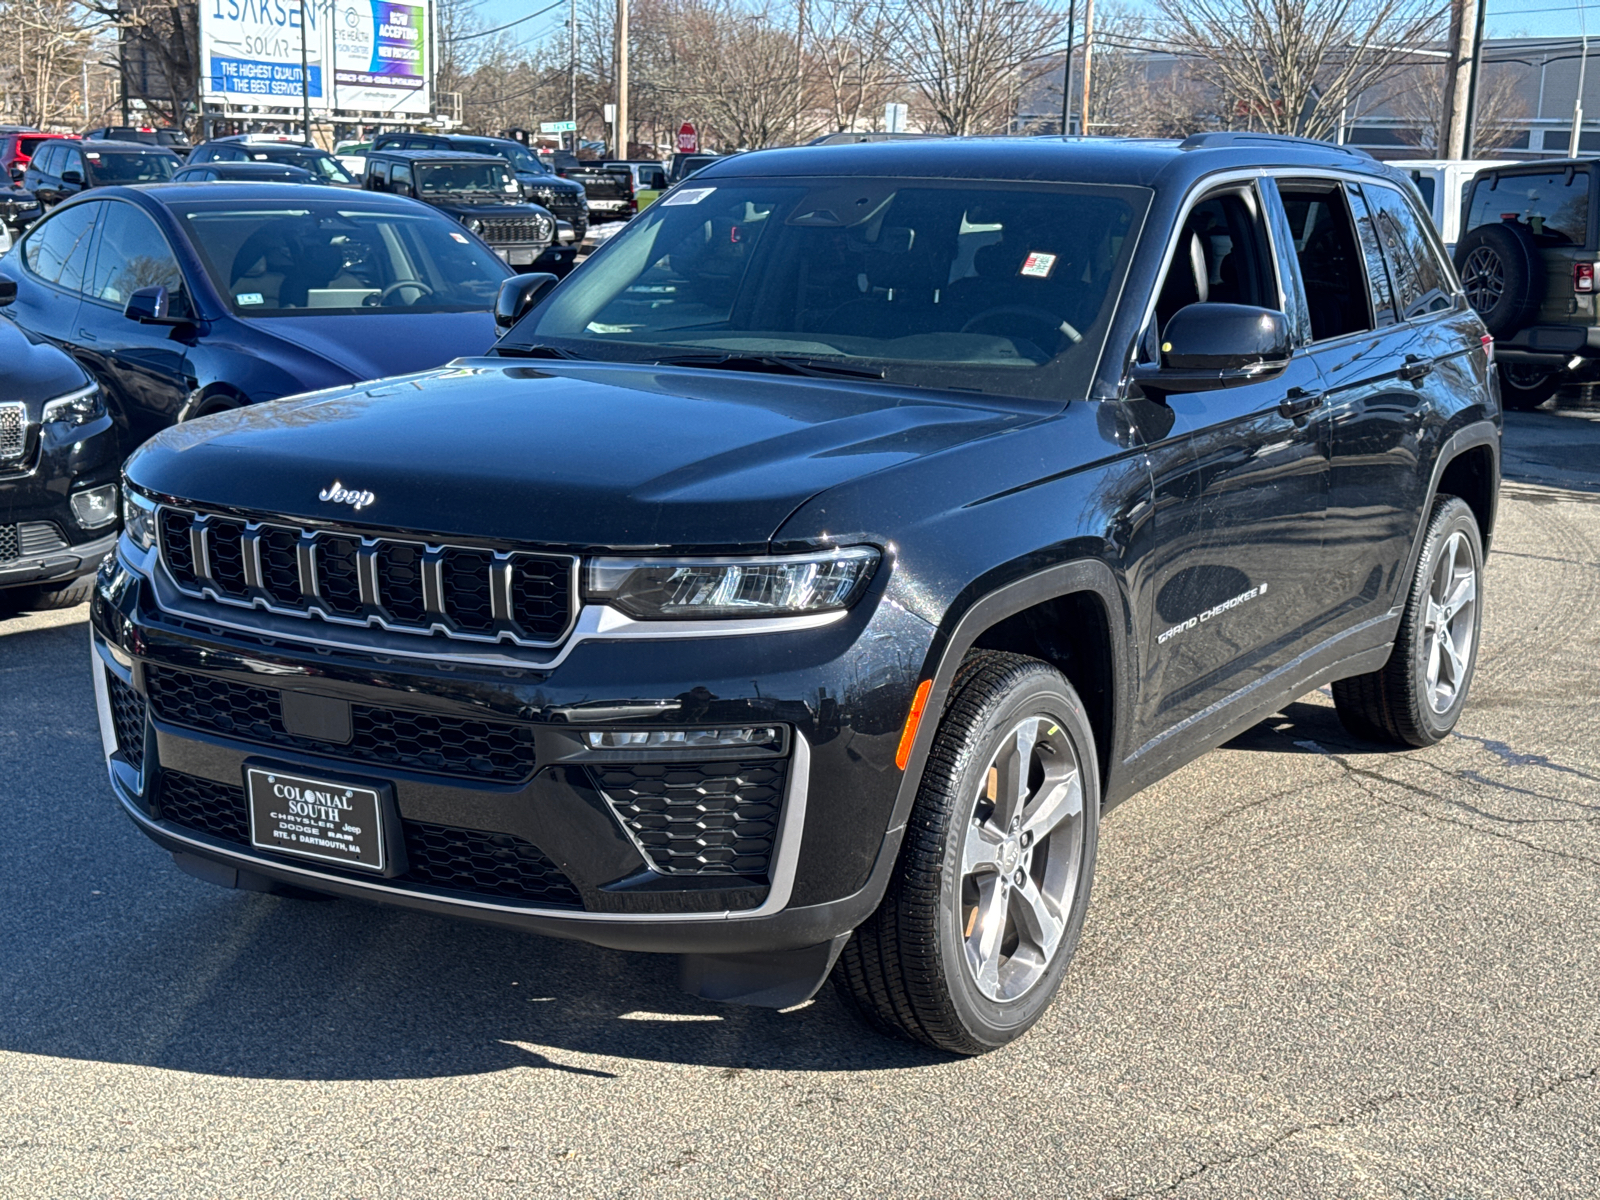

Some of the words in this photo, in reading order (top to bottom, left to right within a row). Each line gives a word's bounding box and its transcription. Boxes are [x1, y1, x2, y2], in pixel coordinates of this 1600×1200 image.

[245, 35, 289, 58] SOLAR
[221, 61, 238, 76] THE
[239, 63, 272, 79] HIGHEST
[232, 78, 249, 92] THE
[250, 79, 270, 94] BEST
[271, 80, 304, 96] SERVICE
[679, 133, 696, 149] STOP
[318, 481, 375, 510] Jeep
[1157, 616, 1198, 645] GRAND
[1199, 587, 1259, 623] CHEROKEE
[273, 783, 353, 811] COLONIAL
[288, 800, 341, 822] SOUTH
[269, 811, 335, 829] CHRYSLER
[341, 823, 362, 835] Jeep
[278, 821, 320, 836] DODGE
[327, 831, 354, 842] RAM
[272, 829, 290, 840] RTE.
[290, 833, 297, 841] 6
[298, 834, 348, 852] DARTMOUTH,
[348, 844, 361, 853] MA
